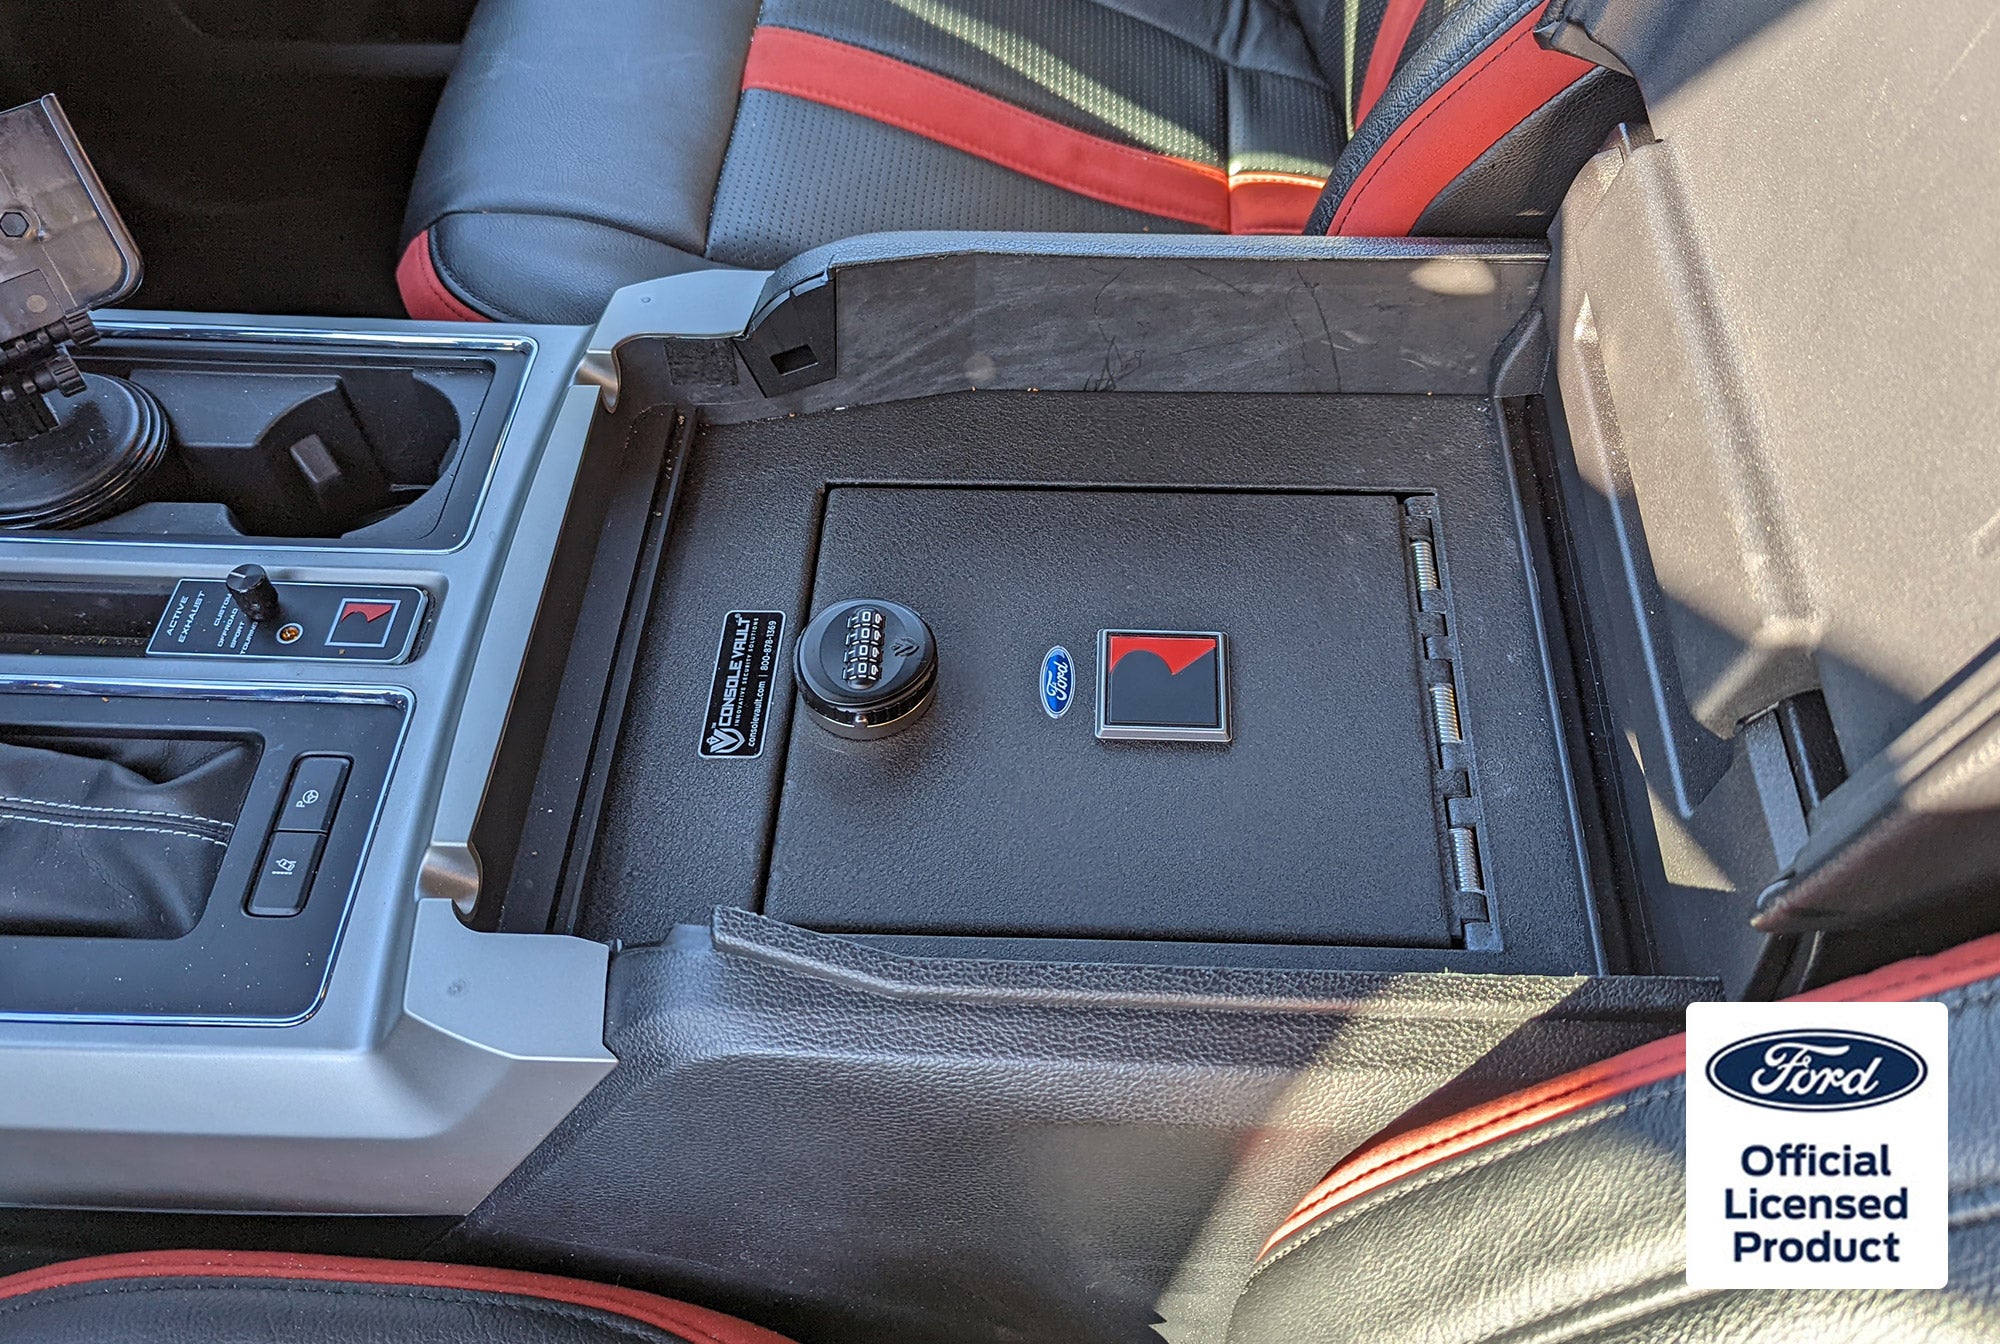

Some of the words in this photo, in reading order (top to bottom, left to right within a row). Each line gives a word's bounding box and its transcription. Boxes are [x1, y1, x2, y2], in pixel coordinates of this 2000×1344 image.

[167, 595, 189, 636] ACTIVE
[178, 590, 206, 643] EXHAUST
[213, 593, 232, 627] CUSTOM
[217, 608, 239, 648] OFFROAD
[230, 621, 245, 649] SPORT
[734, 687, 746, 727] INNOVATIVE
[741, 655, 752, 685] SECURITY
[748, 617, 759, 652] SOLUTIONS
[748, 681, 766, 747] consolevault.com
[760, 620, 777, 671] 800-878-1369
[1046, 661, 1068, 701] Ford
[718, 660, 743, 727] CONSOLE
